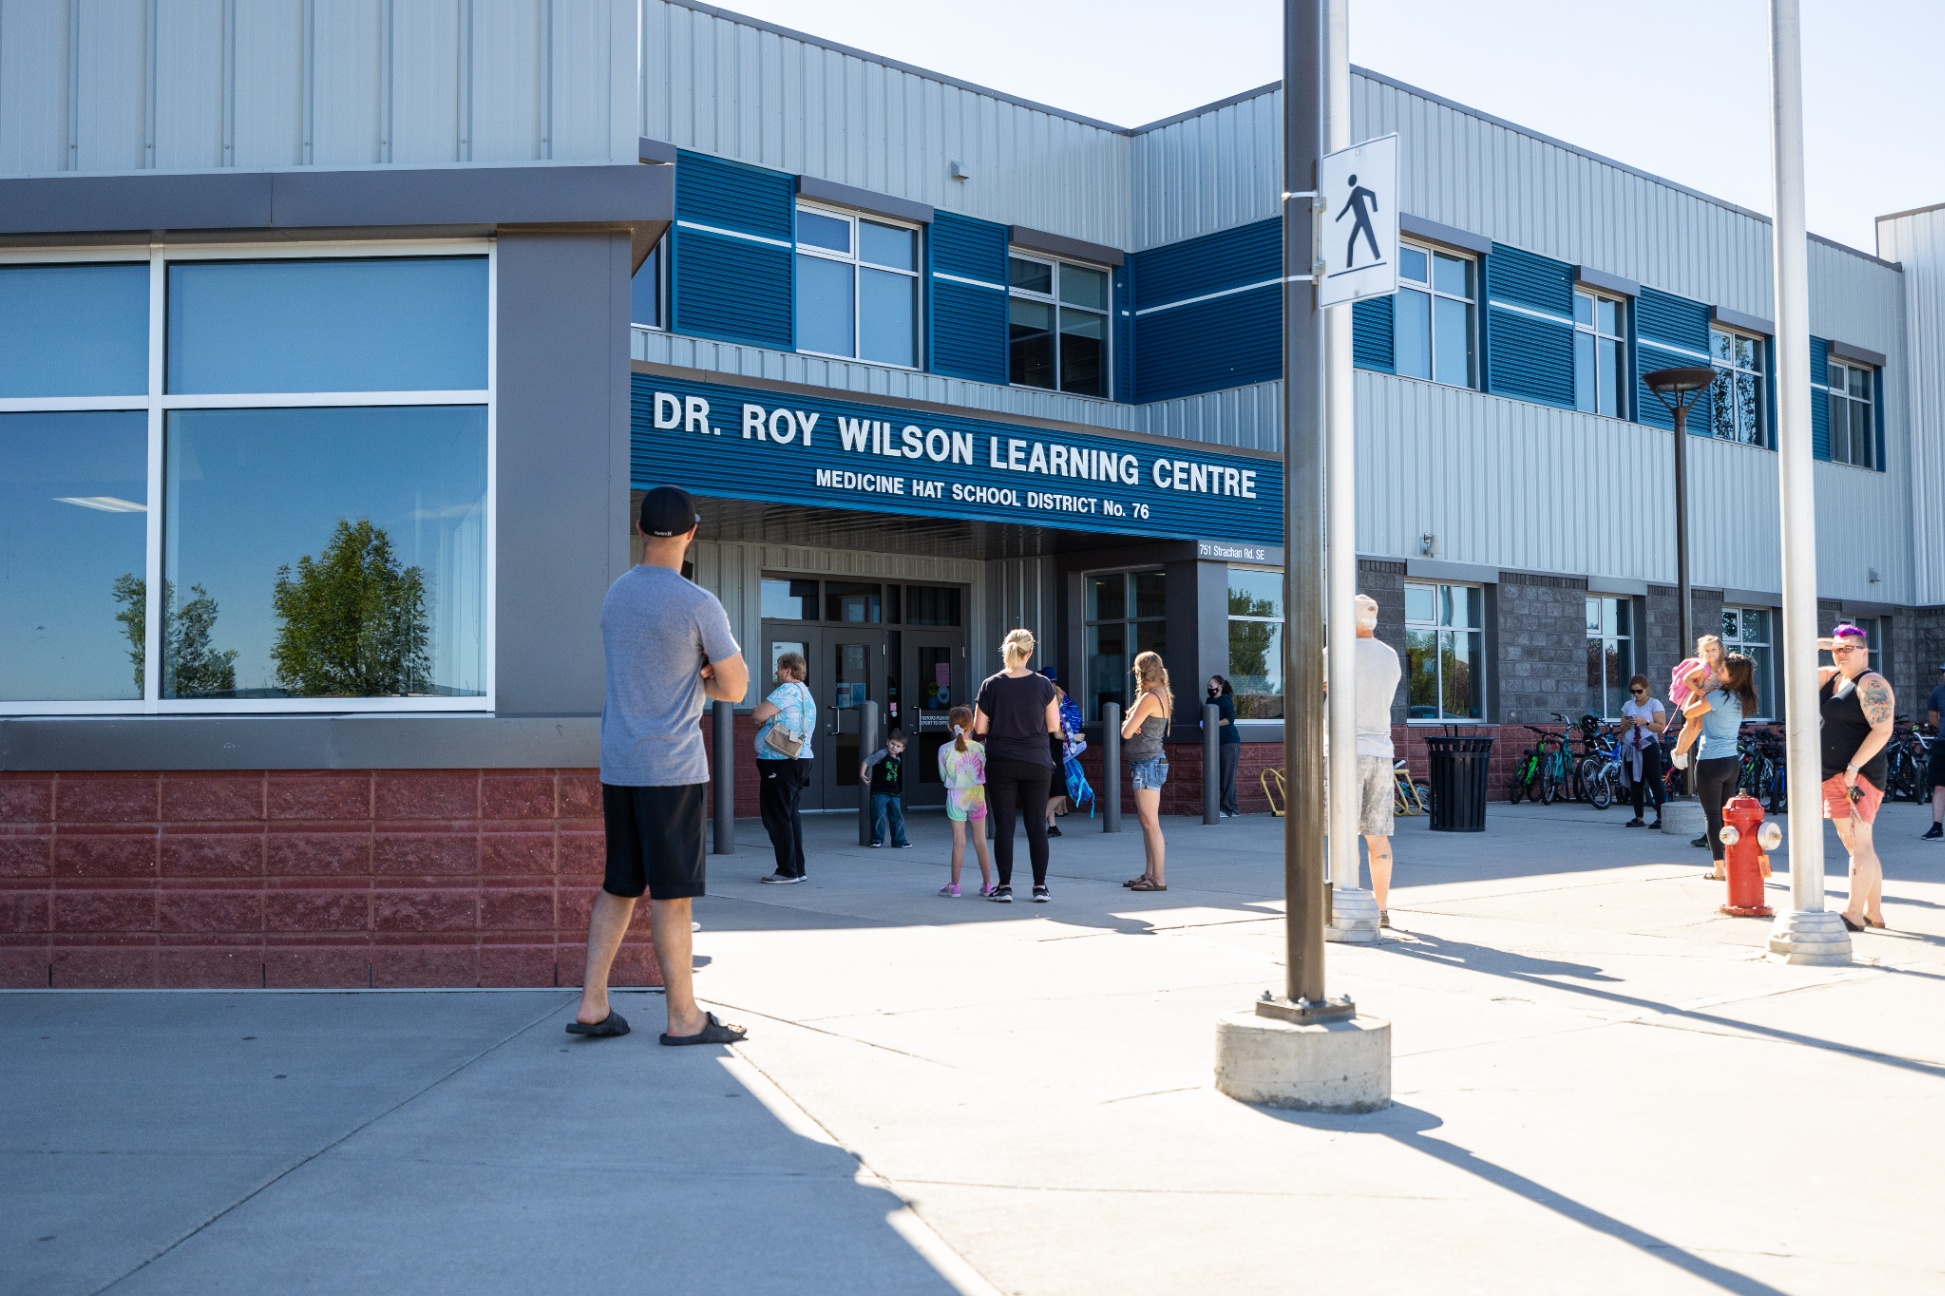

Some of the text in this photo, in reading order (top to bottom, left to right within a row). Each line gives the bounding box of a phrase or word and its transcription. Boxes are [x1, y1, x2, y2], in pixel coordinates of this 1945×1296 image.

[654, 391, 1257, 499] DR. ROY WILSON LEARNING CENTRE
[816, 468, 1150, 520] MEDICINE HAT SCHOOL DISTRICT No. 76
[1200, 544, 1265, 560] 751 Strachan Rd. SE
